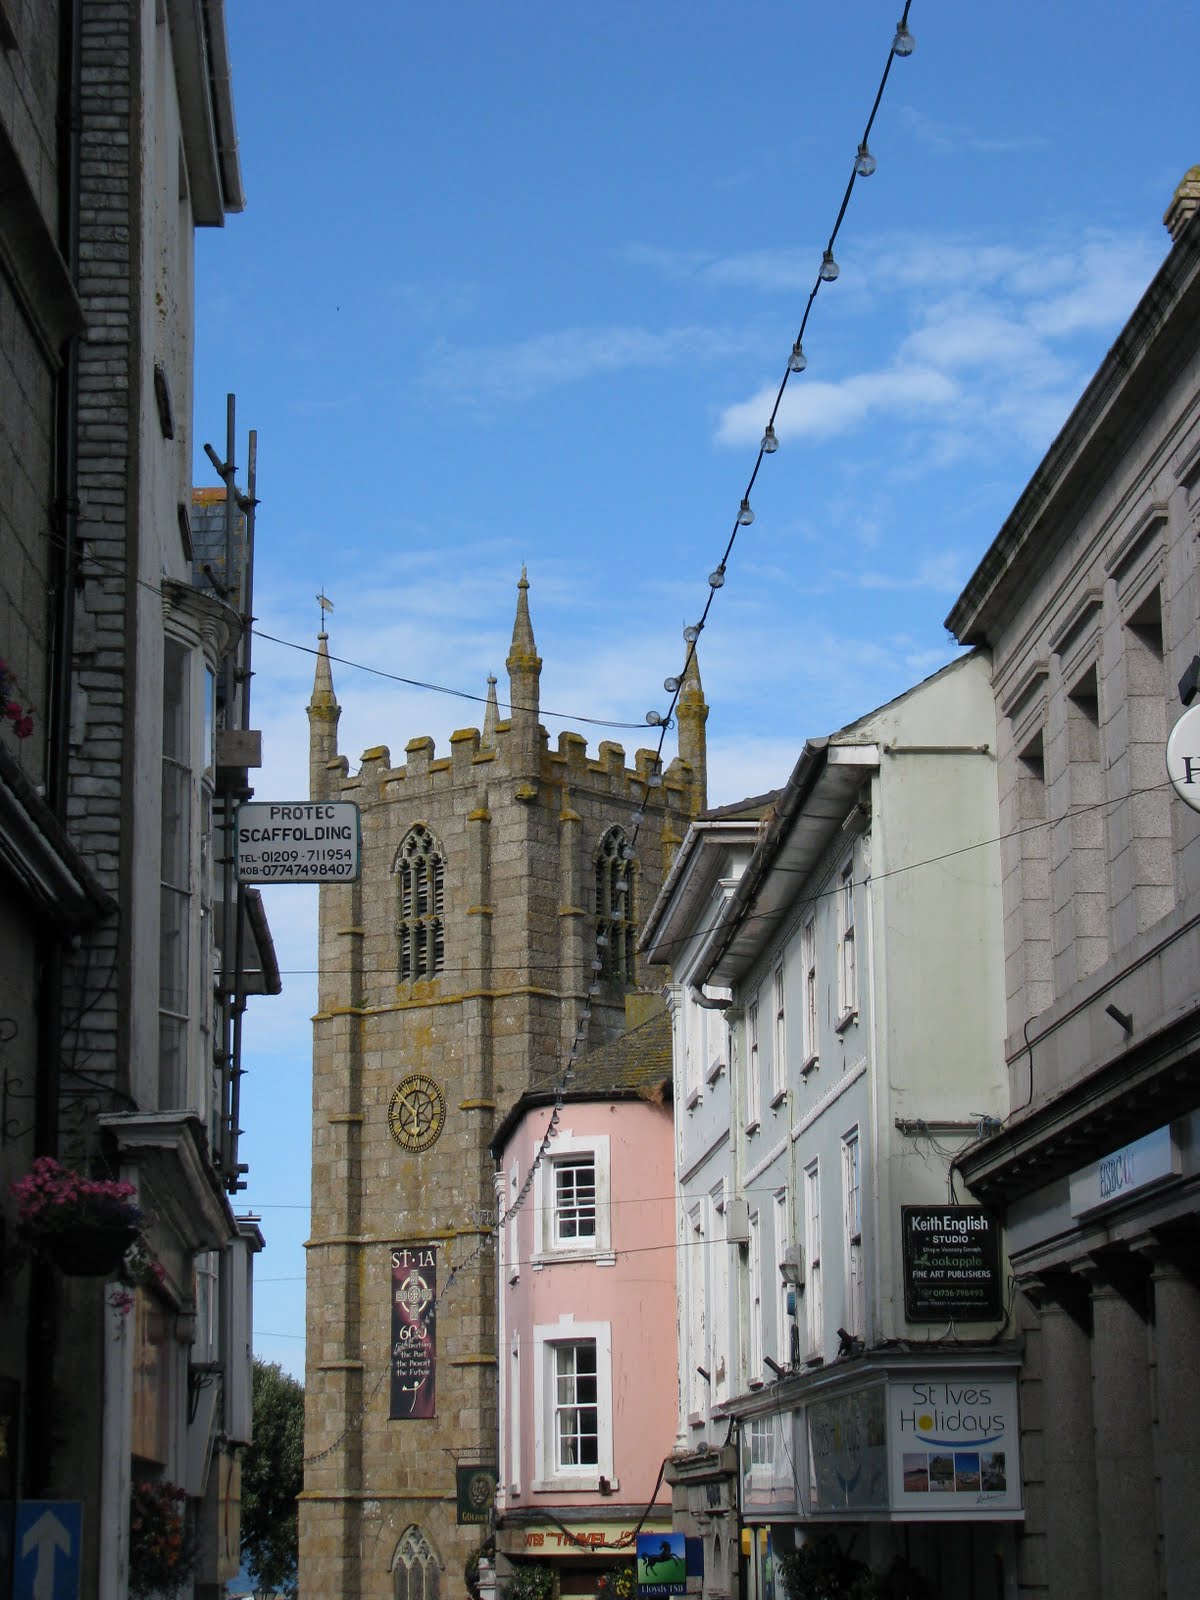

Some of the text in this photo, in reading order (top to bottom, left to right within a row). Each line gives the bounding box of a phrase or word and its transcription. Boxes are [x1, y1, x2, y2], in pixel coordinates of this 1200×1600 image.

[270, 806, 335, 820] PROTEC
[239, 826, 352, 842] SCAFFOLDING
[911, 1215, 988, 1233] Keith English
[932, 1235, 969, 1244] STUDIO
[931, 1256, 982, 1268] oakapple
[912, 1270, 991, 1278] FINE ART PUBLISHERS
[912, 1383, 992, 1405] St Ives
[900, 1409, 1005, 1437] Holidays
[641, 1584, 684, 1594] Lloyds TSB
